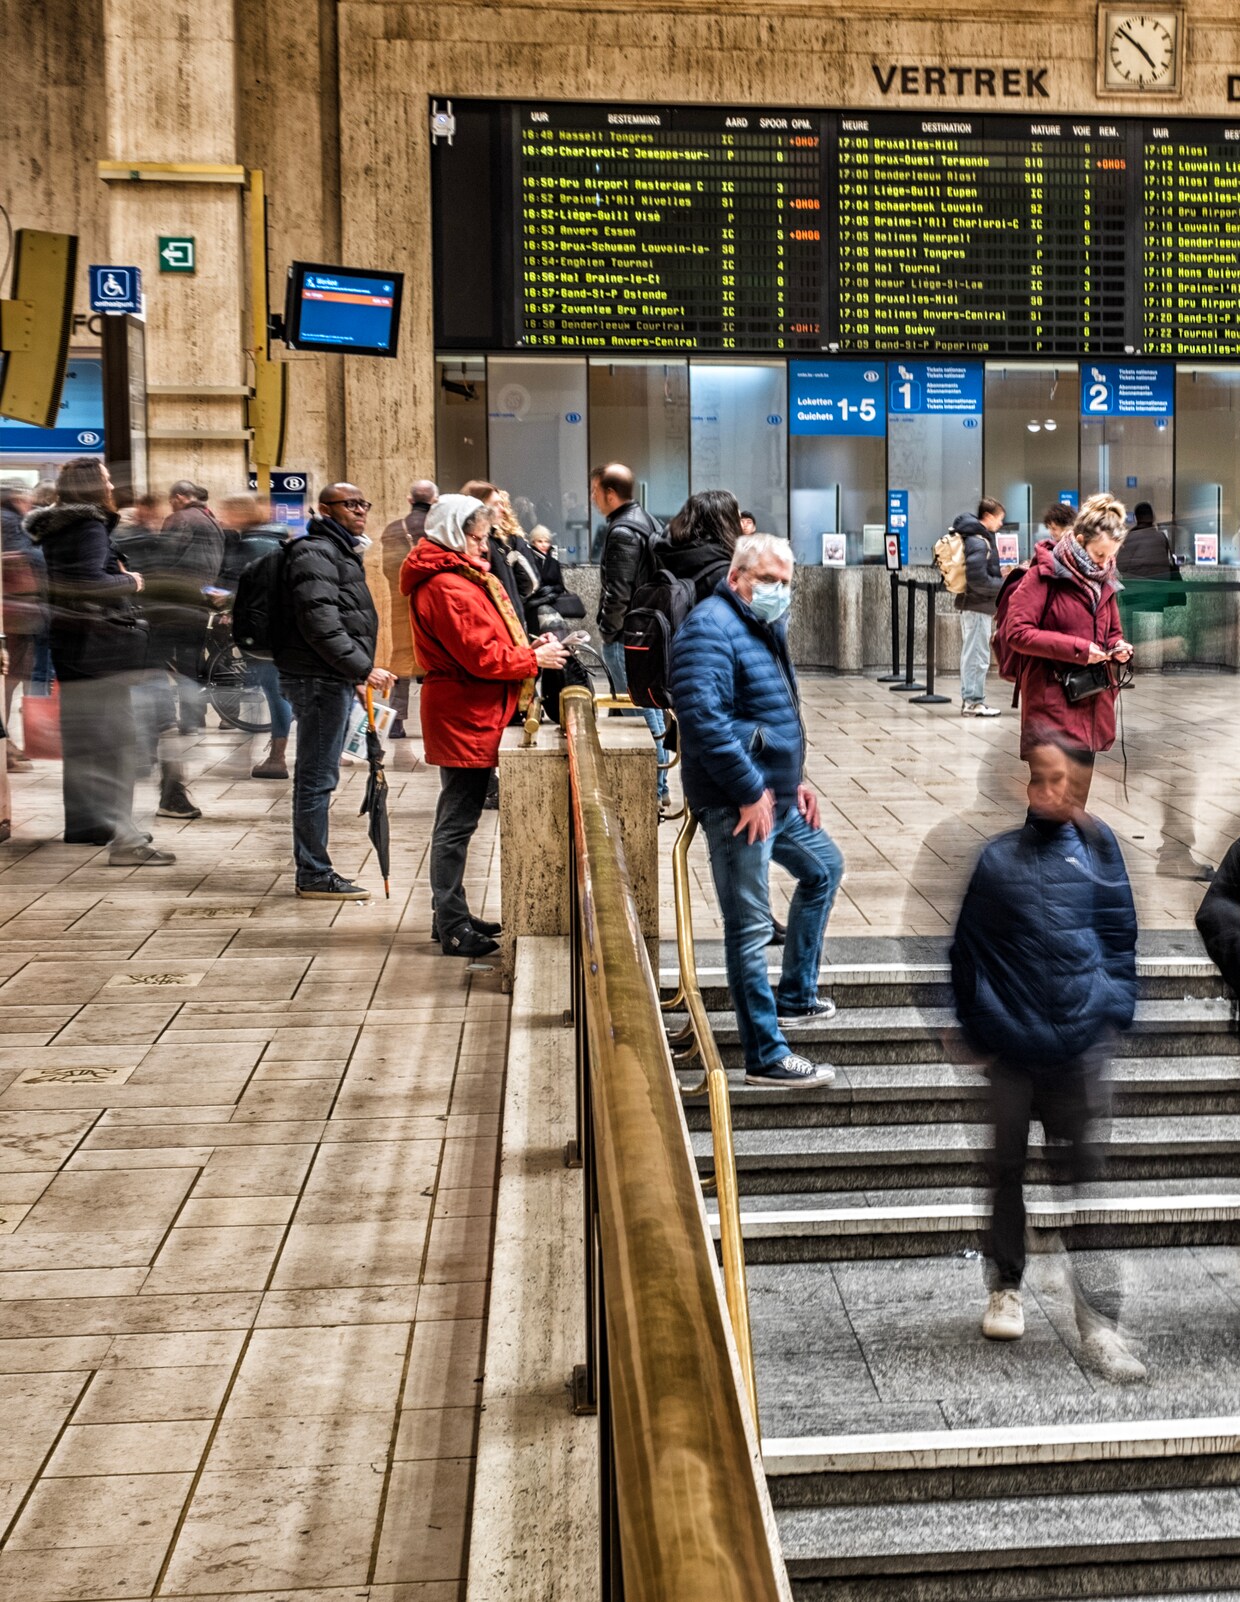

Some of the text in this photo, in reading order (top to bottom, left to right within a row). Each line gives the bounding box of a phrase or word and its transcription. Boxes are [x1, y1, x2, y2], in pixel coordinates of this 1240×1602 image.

[872, 64, 1050, 97] VERTREK
[531, 112, 812, 129] UUR BESTEMMING AARD SPOOR OPM.
[842, 121, 1119, 137] HEURE DESTINATION NATURE VOIE REM.
[1153, 128, 1169, 138] UUR
[722, 135, 734, 145] IC
[1031, 142, 1042, 153] IC
[722, 181, 734, 192] IC
[1031, 188, 1042, 199] IC
[1031, 219, 1042, 230] IC
[722, 229, 734, 239] IC
[1031, 265, 1042, 276] IC
[1031, 280, 1042, 291] IC
[797, 397, 833, 406] Loketten
[899, 383, 911, 409] 1
[1089, 384, 1108, 411] 2
[837, 398, 876, 422] 1-5
[797, 412, 834, 421] Guichets
